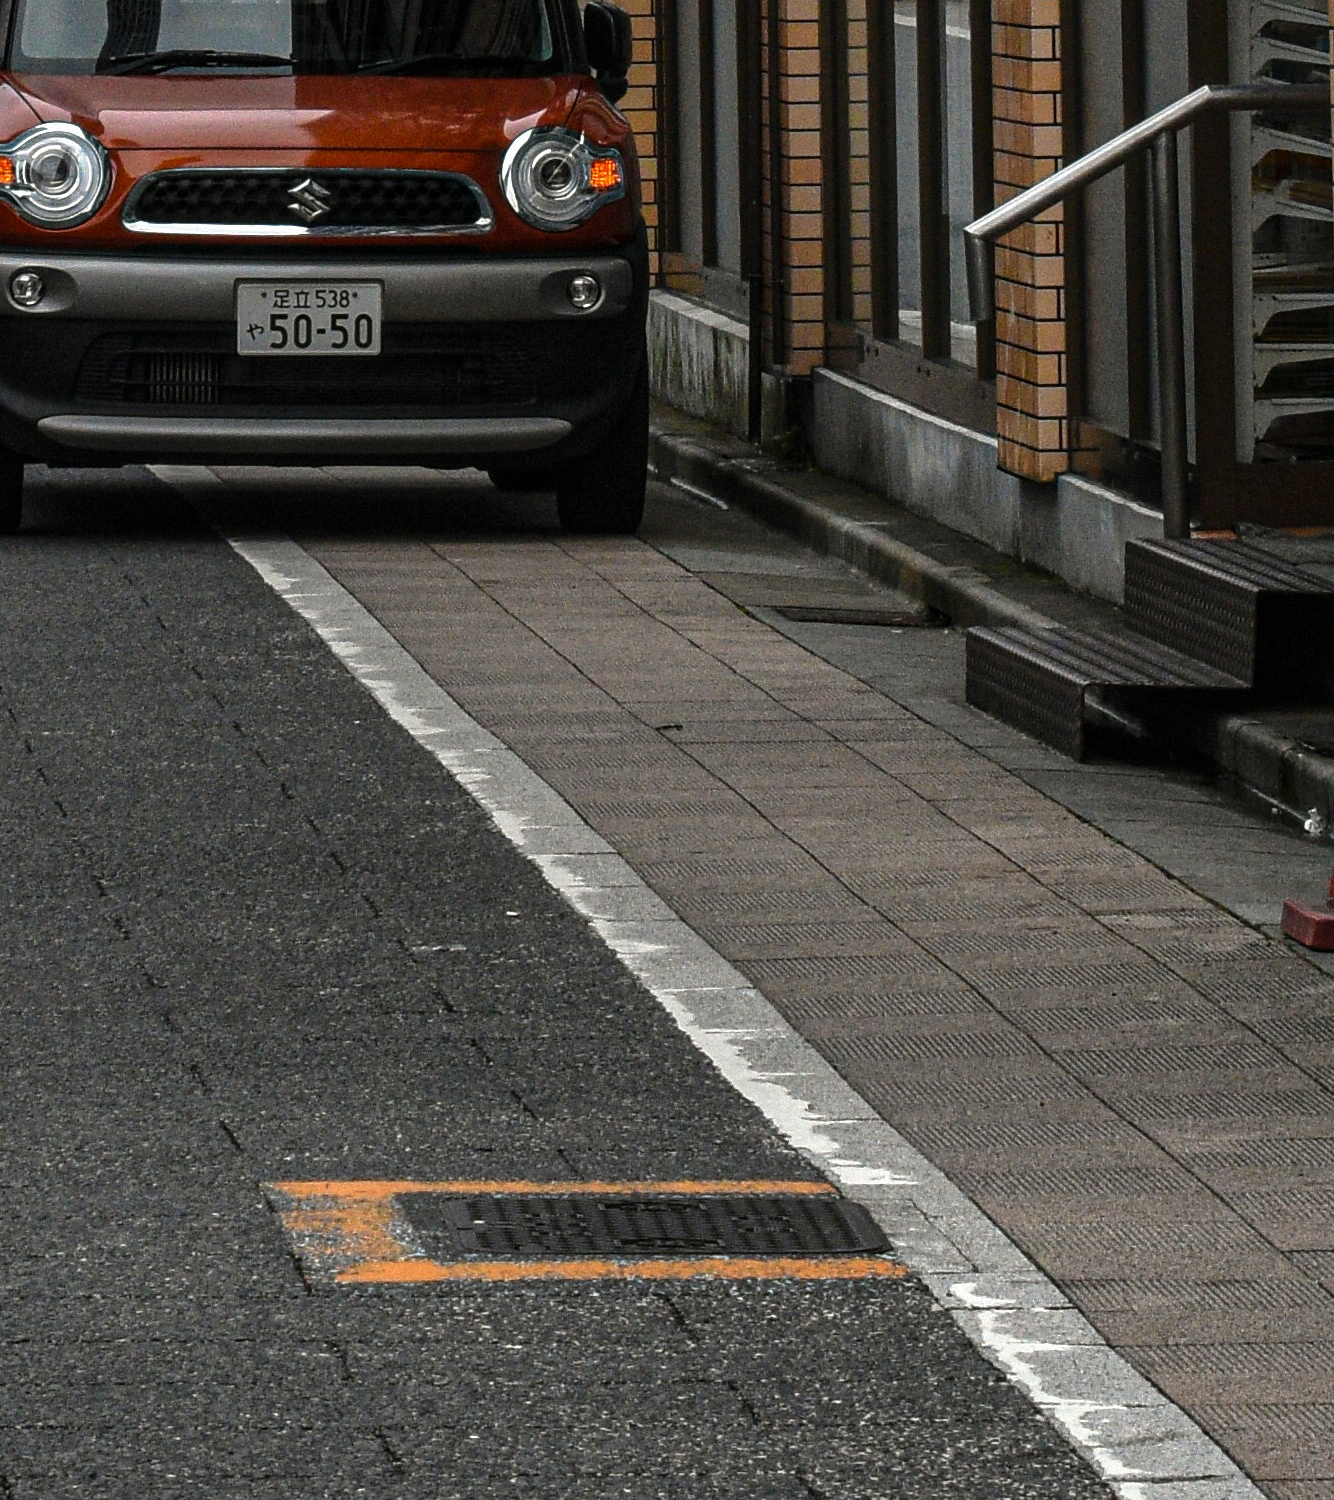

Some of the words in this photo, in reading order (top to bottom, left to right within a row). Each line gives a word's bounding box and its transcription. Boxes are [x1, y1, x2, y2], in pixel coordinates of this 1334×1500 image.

[272, 289, 311, 308] 足立
[315, 289, 350, 308] 538
[246, 322, 265, 341] や
[269, 313, 373, 349] 50-50
